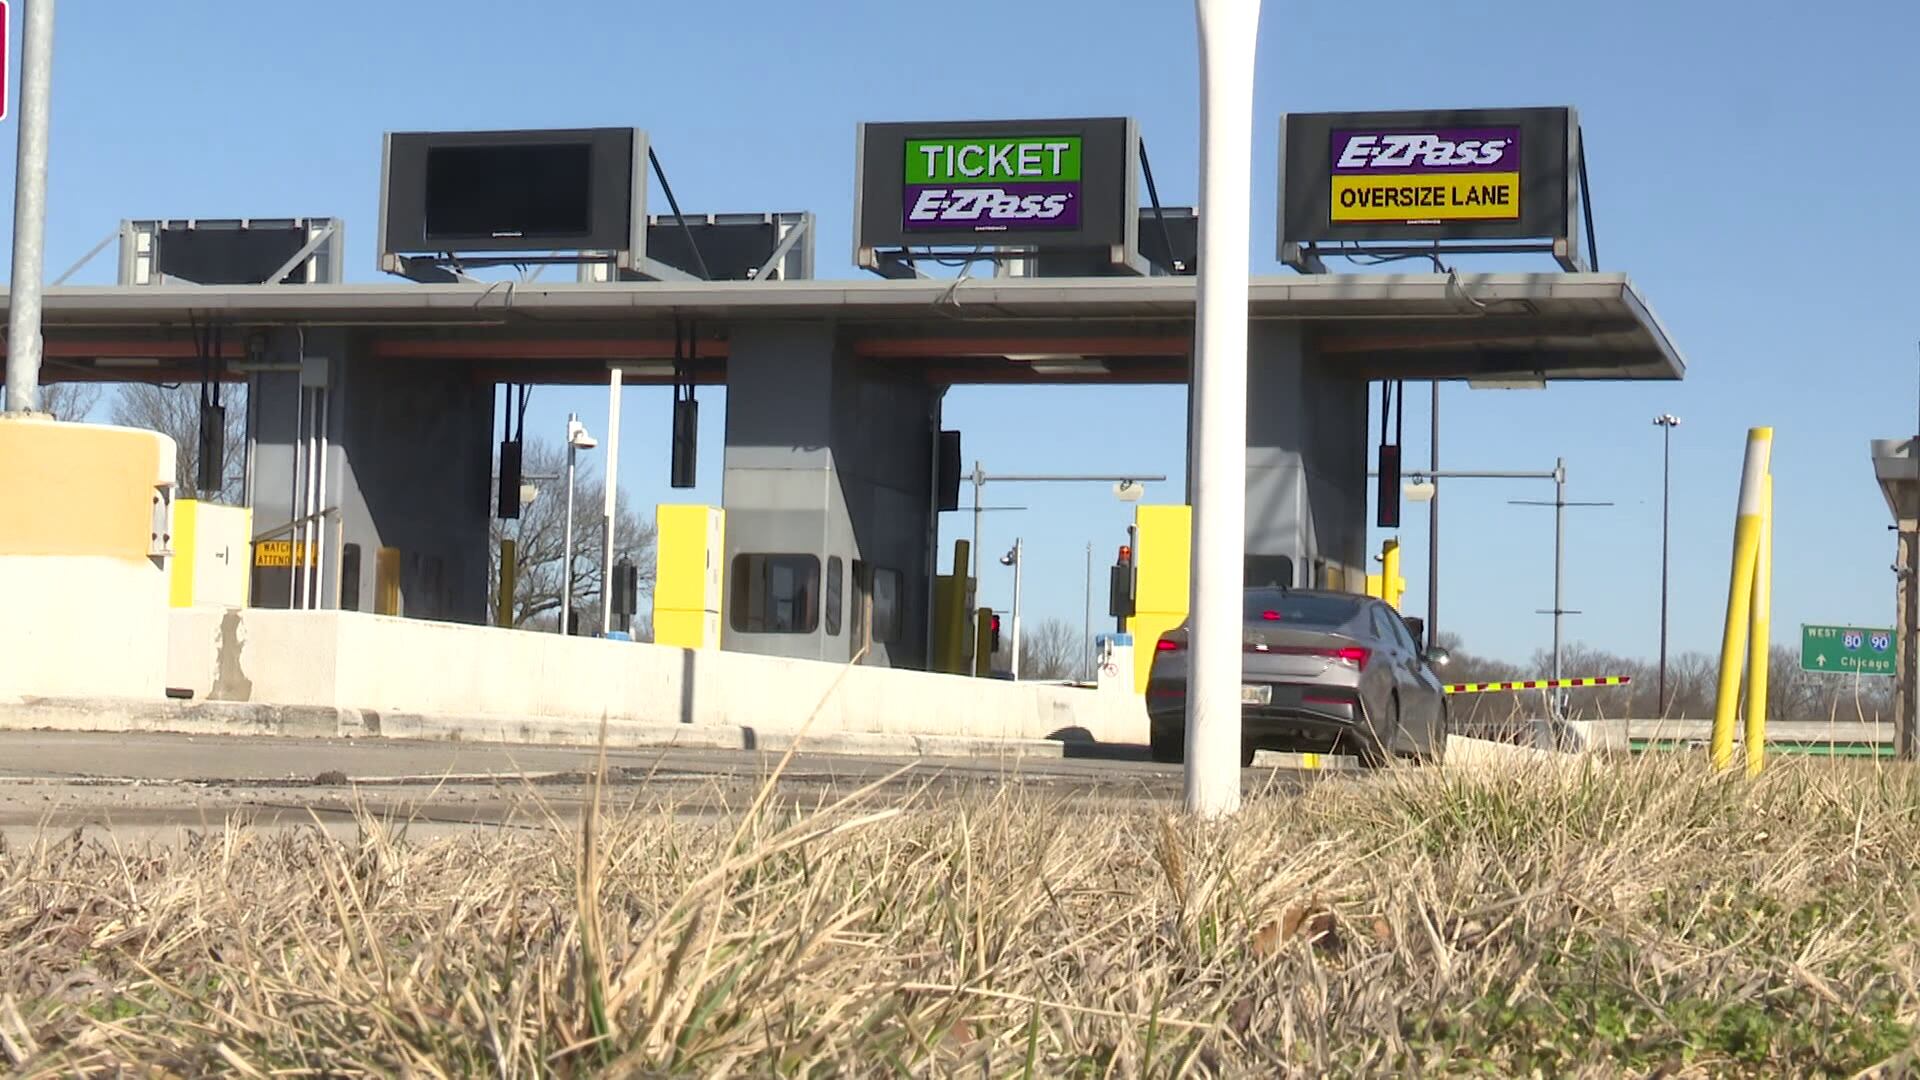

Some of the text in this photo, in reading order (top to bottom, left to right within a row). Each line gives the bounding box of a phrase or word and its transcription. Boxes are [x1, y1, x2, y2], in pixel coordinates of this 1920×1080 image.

[920, 143, 1069, 176] TICKET
[1340, 185, 1510, 208] OVERSIZE LANE
[1807, 628, 1888, 649] WEST 80 90
[1840, 657, 1889, 671] Chicago
